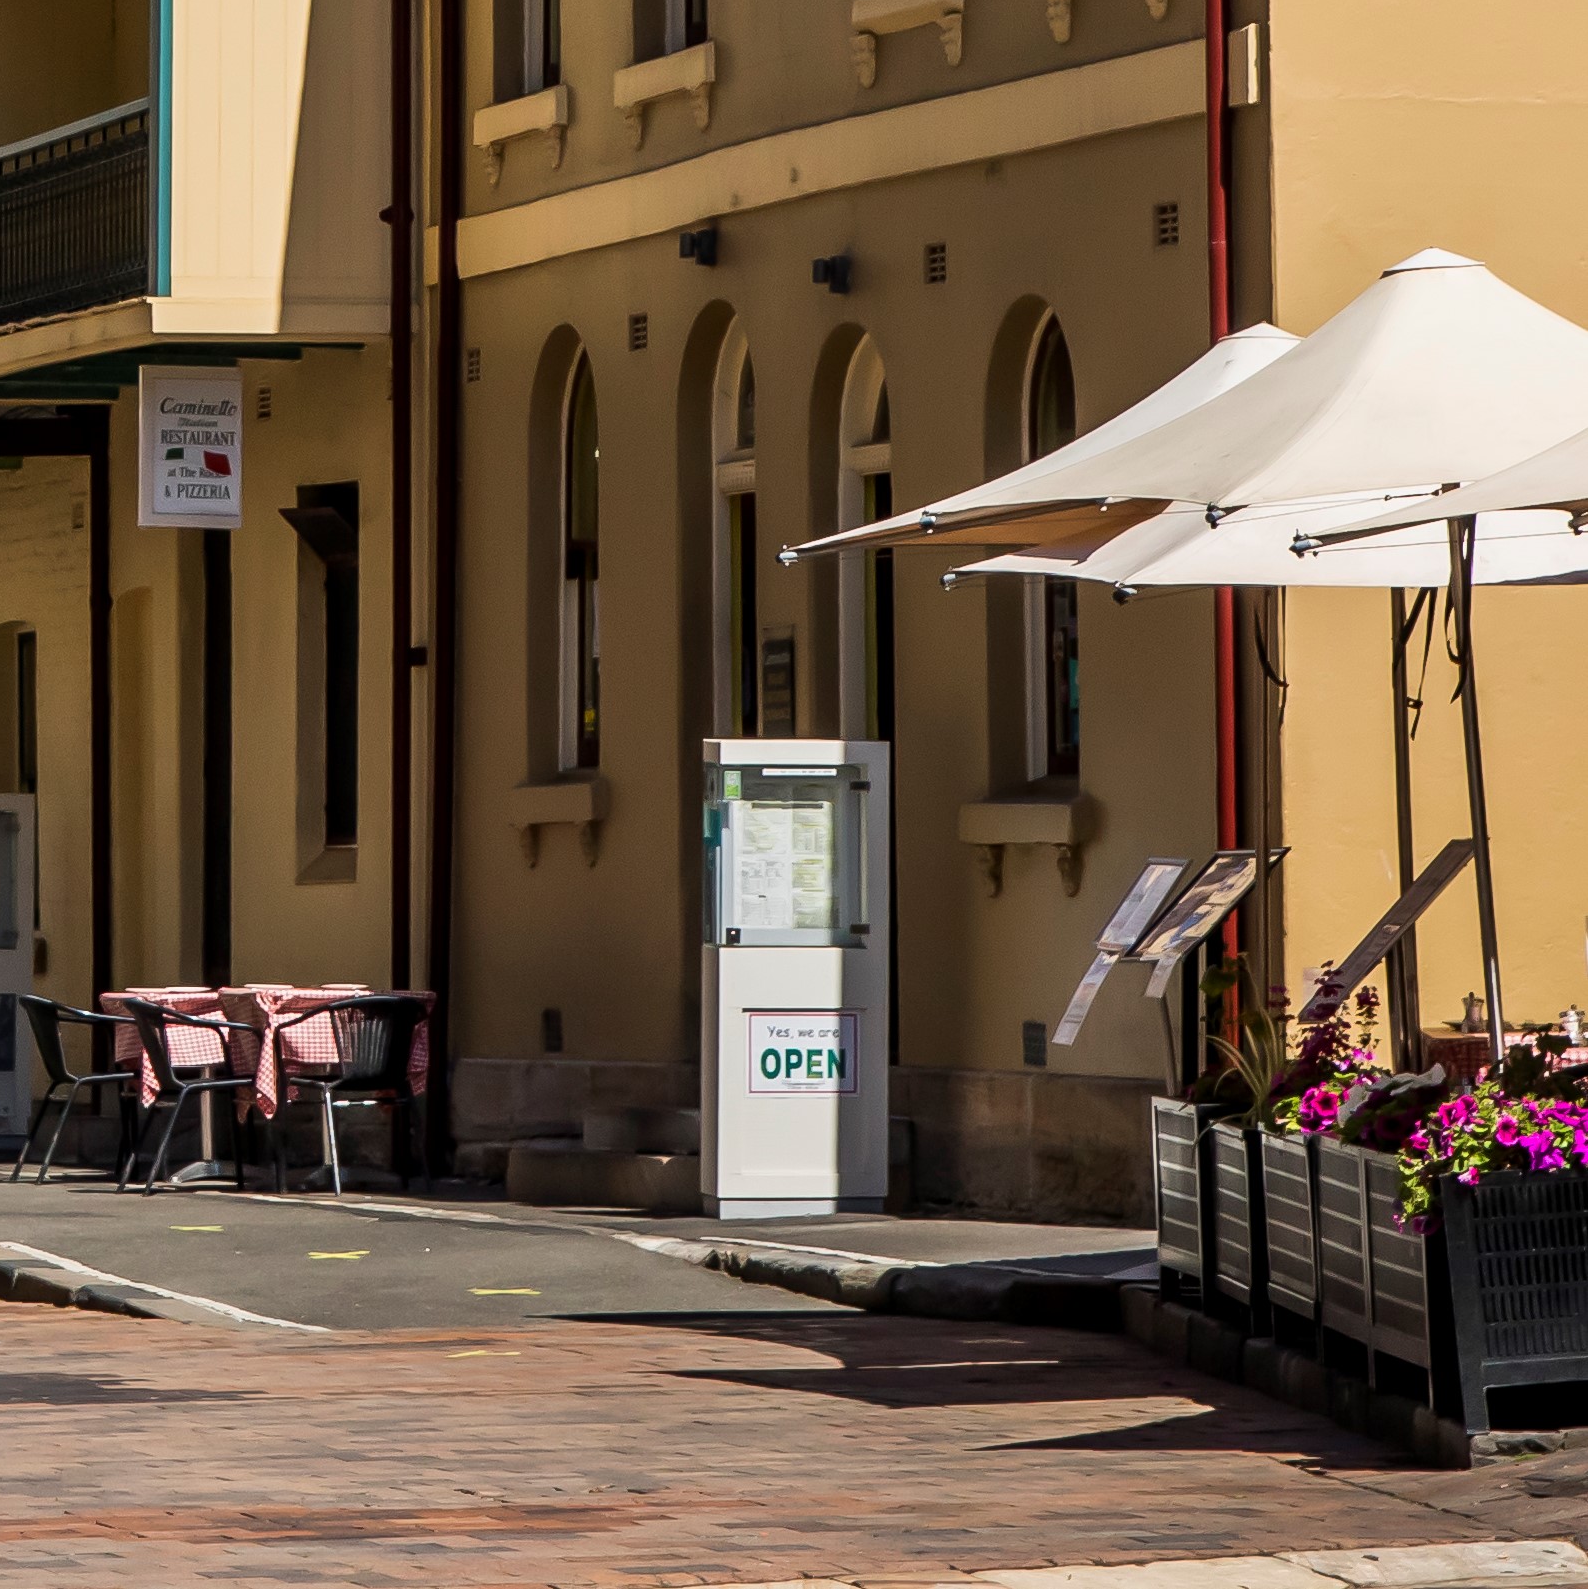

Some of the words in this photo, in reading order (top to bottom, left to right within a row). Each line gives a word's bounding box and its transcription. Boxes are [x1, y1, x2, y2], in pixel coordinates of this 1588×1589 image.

[160, 429, 237, 446] RESTAURANT
[180, 466, 197, 478] The
[177, 484, 231, 500] PIZZERIA
[766, 1025, 794, 1039] Yes,
[797, 1028, 815, 1038] we
[818, 1028, 840, 1038] are
[760, 1047, 846, 1080] OPEN
